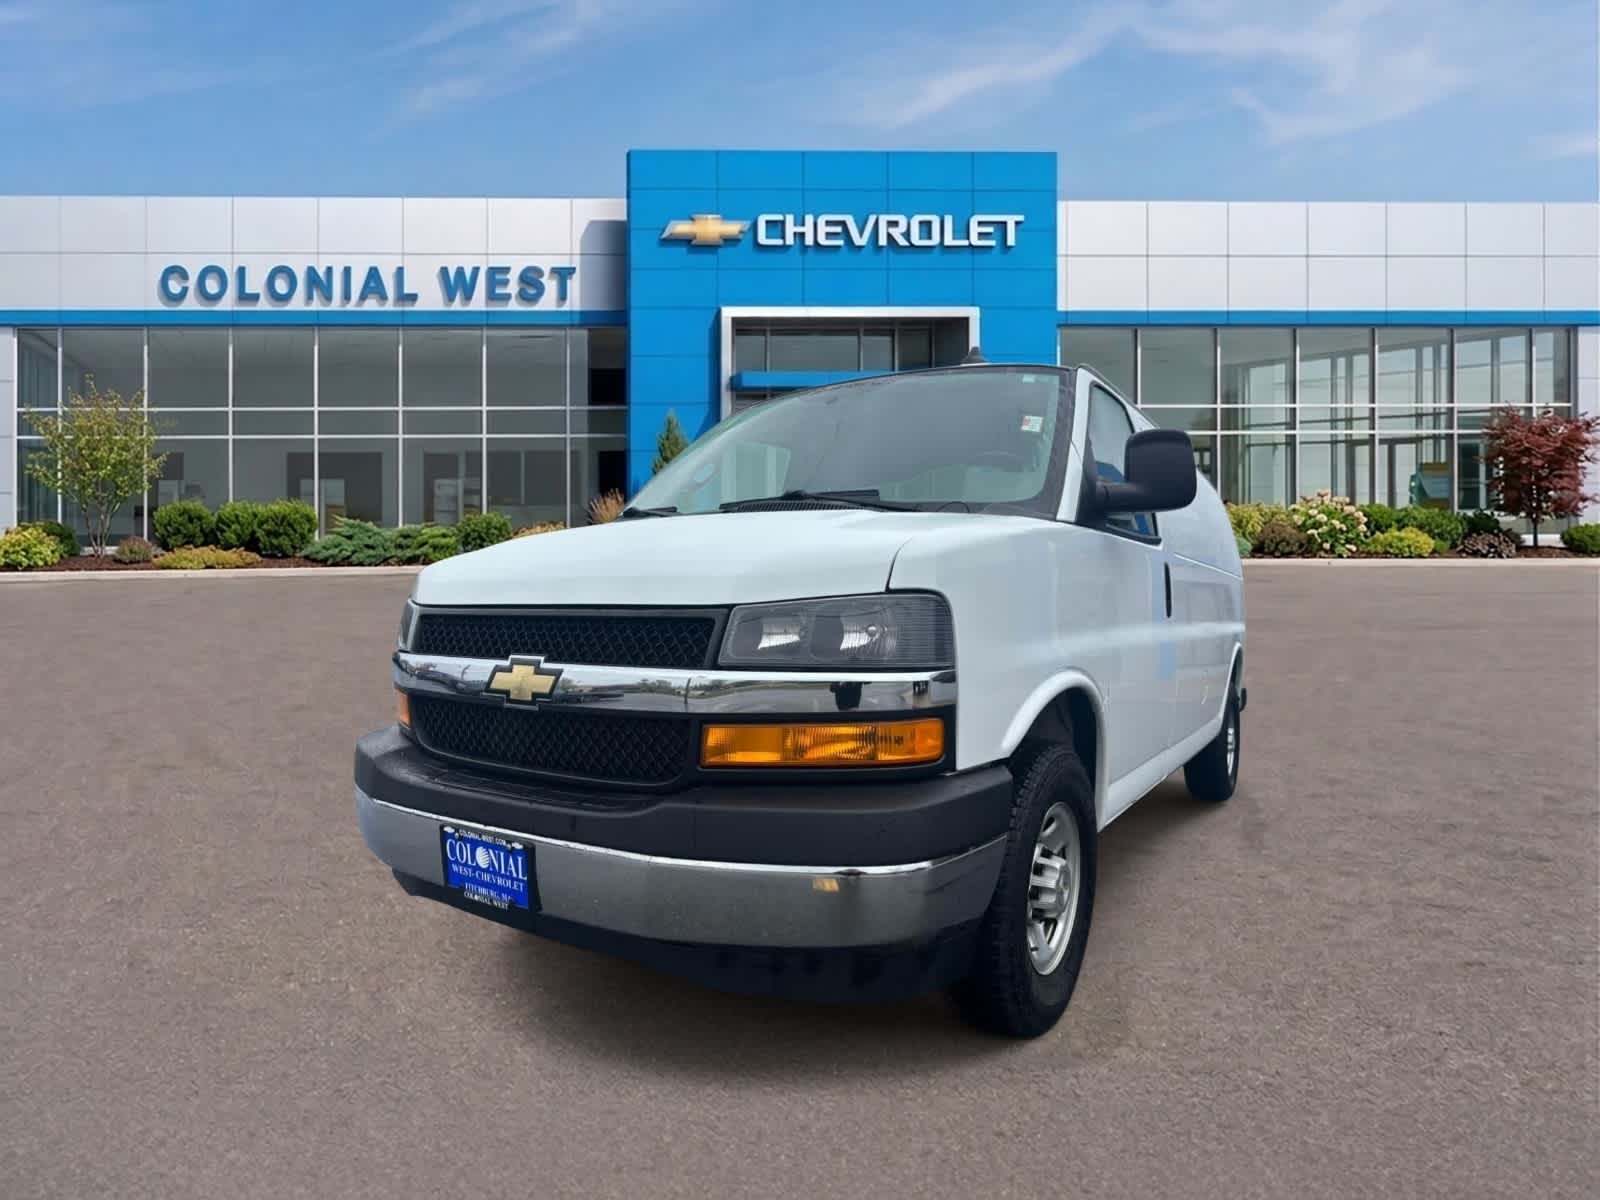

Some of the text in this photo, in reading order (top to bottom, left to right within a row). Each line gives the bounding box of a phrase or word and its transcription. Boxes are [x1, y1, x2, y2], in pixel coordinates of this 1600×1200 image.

[756, 213, 1025, 248] CHEVROLET
[160, 264, 577, 304] COLONIAL WEST
[446, 838, 527, 880] COLONIAL
[492, 899, 508, 910] WEST
